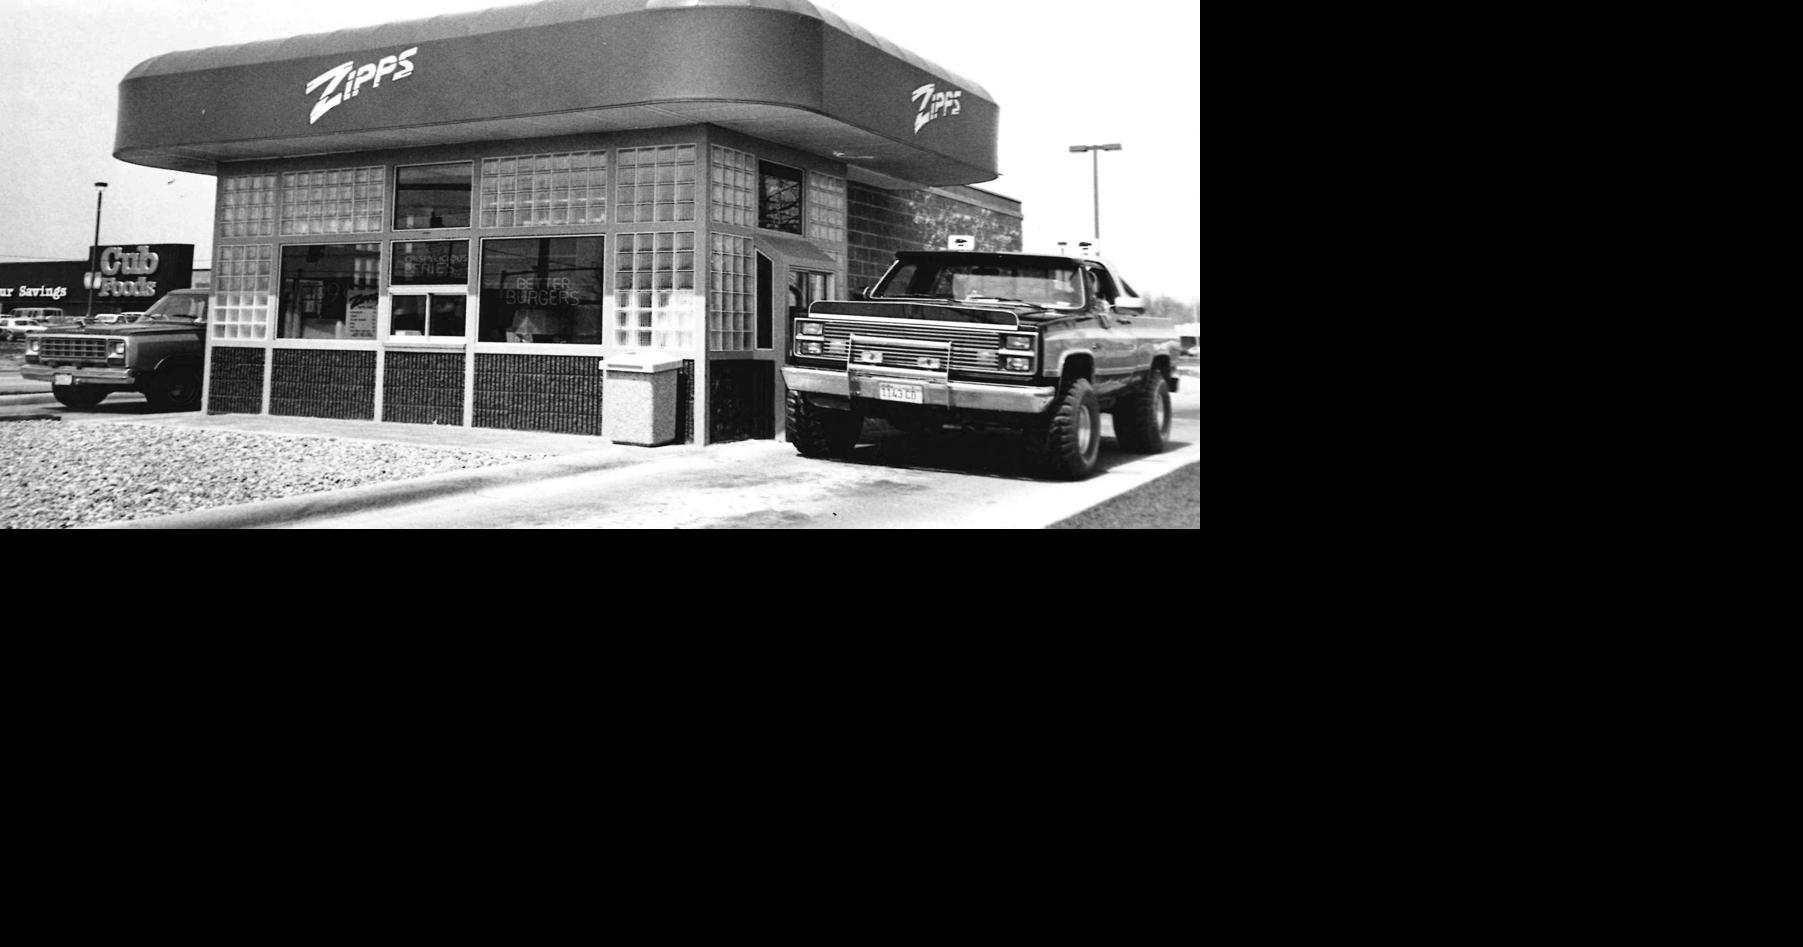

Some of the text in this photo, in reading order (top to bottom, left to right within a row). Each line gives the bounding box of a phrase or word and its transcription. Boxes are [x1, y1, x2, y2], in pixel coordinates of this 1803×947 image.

[100, 246, 159, 275] Cub
[19, 285, 67, 299] Savings
[98, 277, 157, 297] Foods
[516, 277, 571, 291] BETTER
[505, 290, 581, 307] BURGERS
